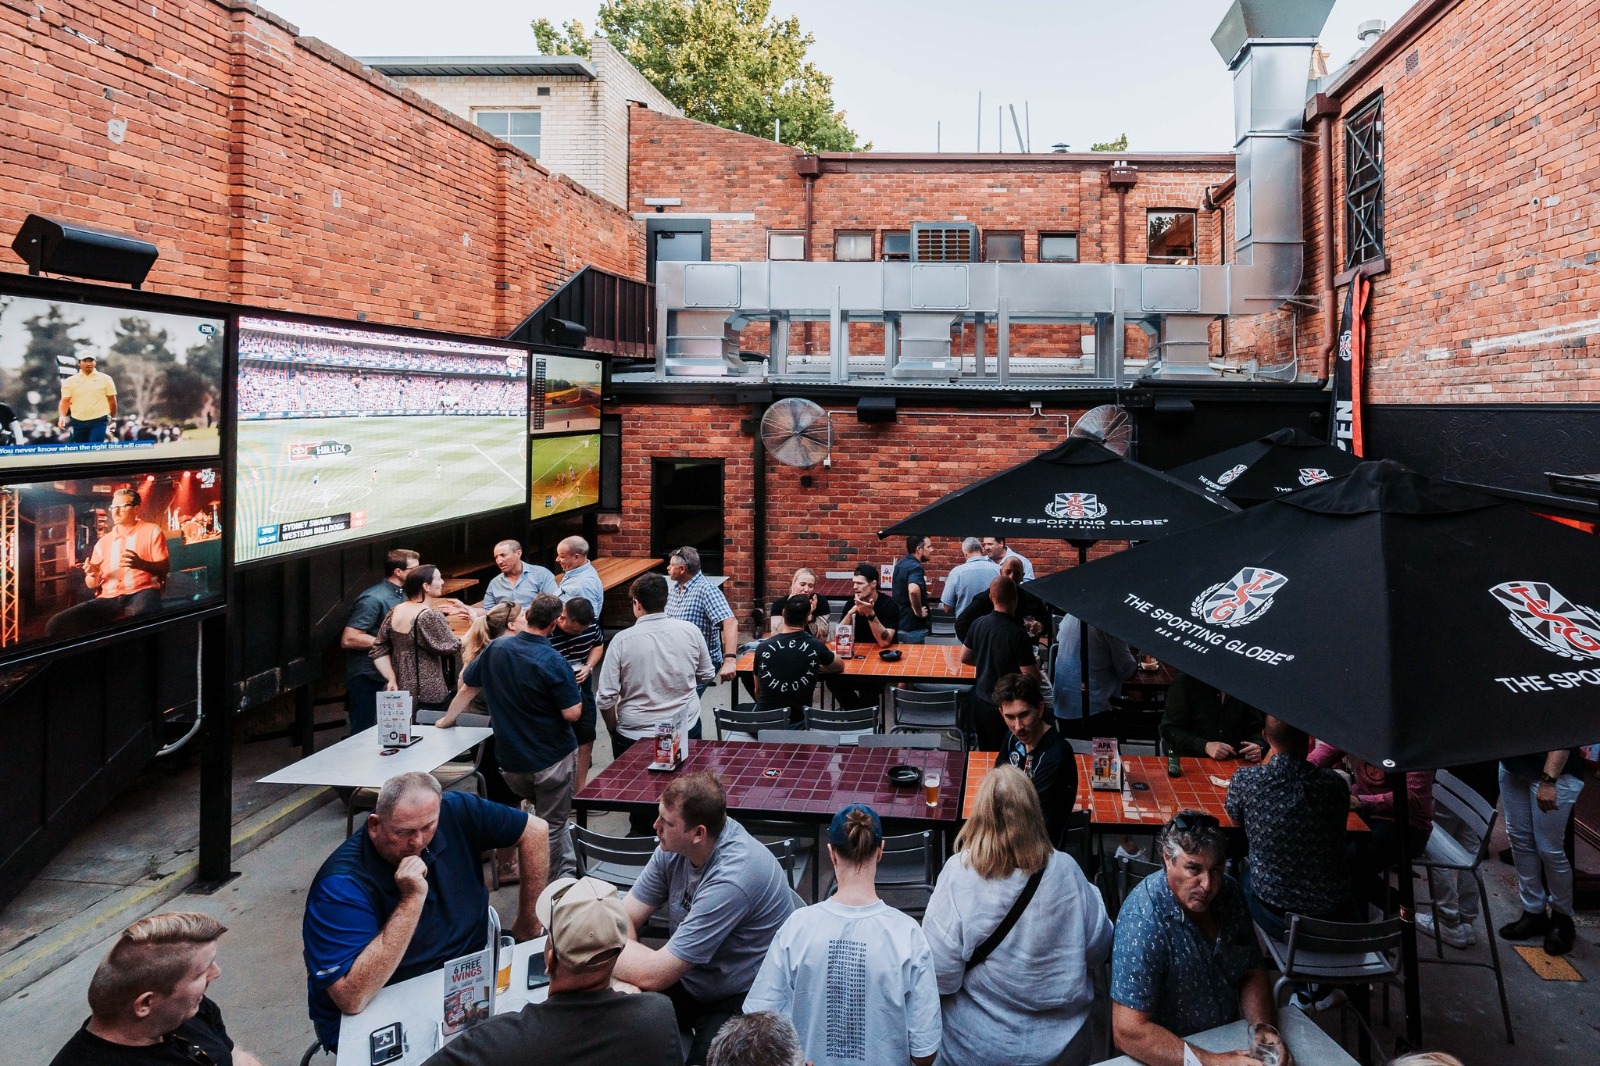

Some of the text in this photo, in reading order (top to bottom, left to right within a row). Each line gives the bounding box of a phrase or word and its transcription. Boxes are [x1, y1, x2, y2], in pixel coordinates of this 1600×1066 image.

[201, 325, 213, 333] FOX
[91, 443, 107, 451] right
[316, 444, 346, 455] HILUX
[282, 516, 332, 532] SYDNEY SWANS
[991, 516, 1022, 524] THE
[1026, 518, 1105, 526] SPORTING
[282, 522, 345, 541] WESTERN BULLDOGS
[1123, 592, 1154, 613] THE
[1150, 607, 1227, 646] SPORTING
[761, 639, 818, 659] SILENT
[1154, 627, 1172, 638] BAR
[1182, 639, 1210, 654] GRILL
[761, 670, 815, 693] THEORY
[1494, 675, 1555, 693] THE
[451, 966, 482, 983] WINGS
[453, 965, 459, 975] 6
[460, 958, 481, 973] FREE
